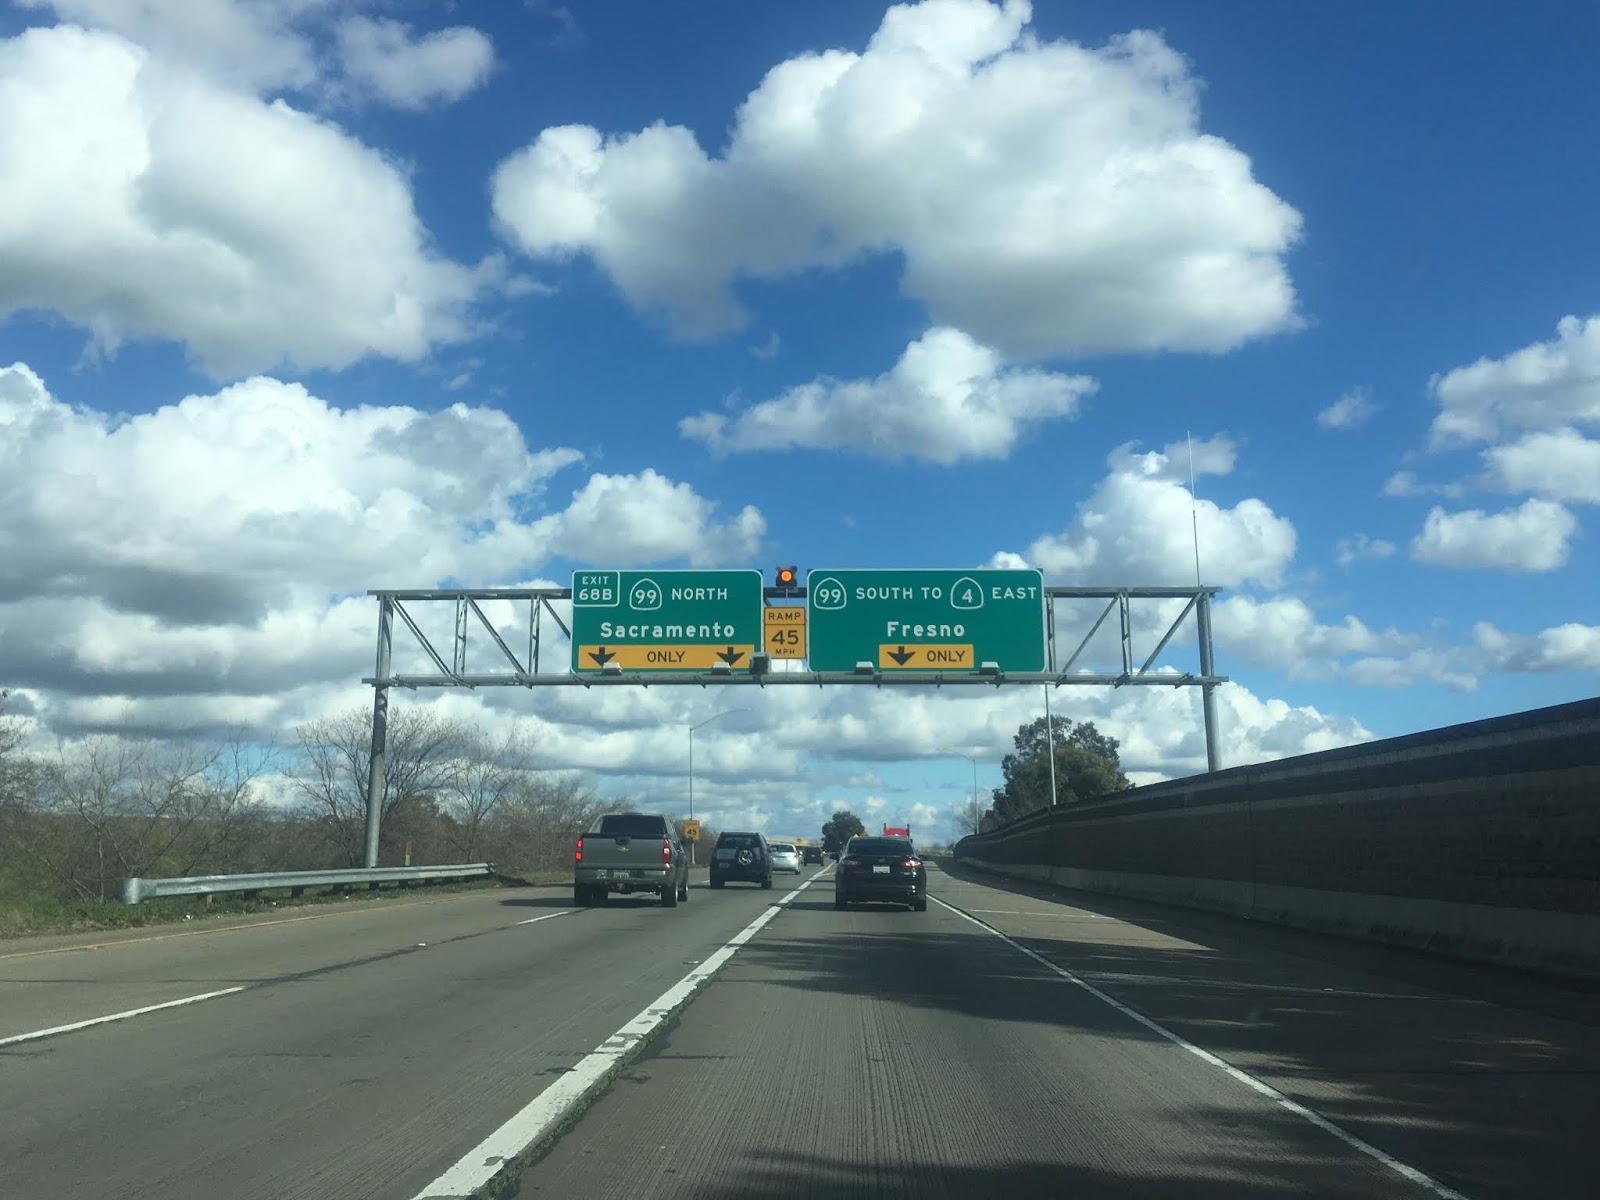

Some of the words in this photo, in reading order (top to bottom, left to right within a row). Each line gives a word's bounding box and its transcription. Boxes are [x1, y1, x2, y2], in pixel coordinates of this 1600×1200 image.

[582, 576, 609, 585] EXIT
[579, 588, 612, 600] 68B
[635, 589, 657, 604] 99
[671, 588, 728, 600] NORTH
[820, 588, 841, 603] 99
[856, 587, 913, 599] SOUTH
[921, 587, 942, 599] TO
[961, 588, 973, 603] 4
[992, 587, 1037, 599] EAST
[768, 612, 801, 620] RAMP
[600, 621, 735, 638] Sacramento
[887, 621, 965, 637] Fresno
[771, 630, 799, 645] 45
[646, 650, 686, 663] ONLY
[926, 650, 966, 662] ONLY
